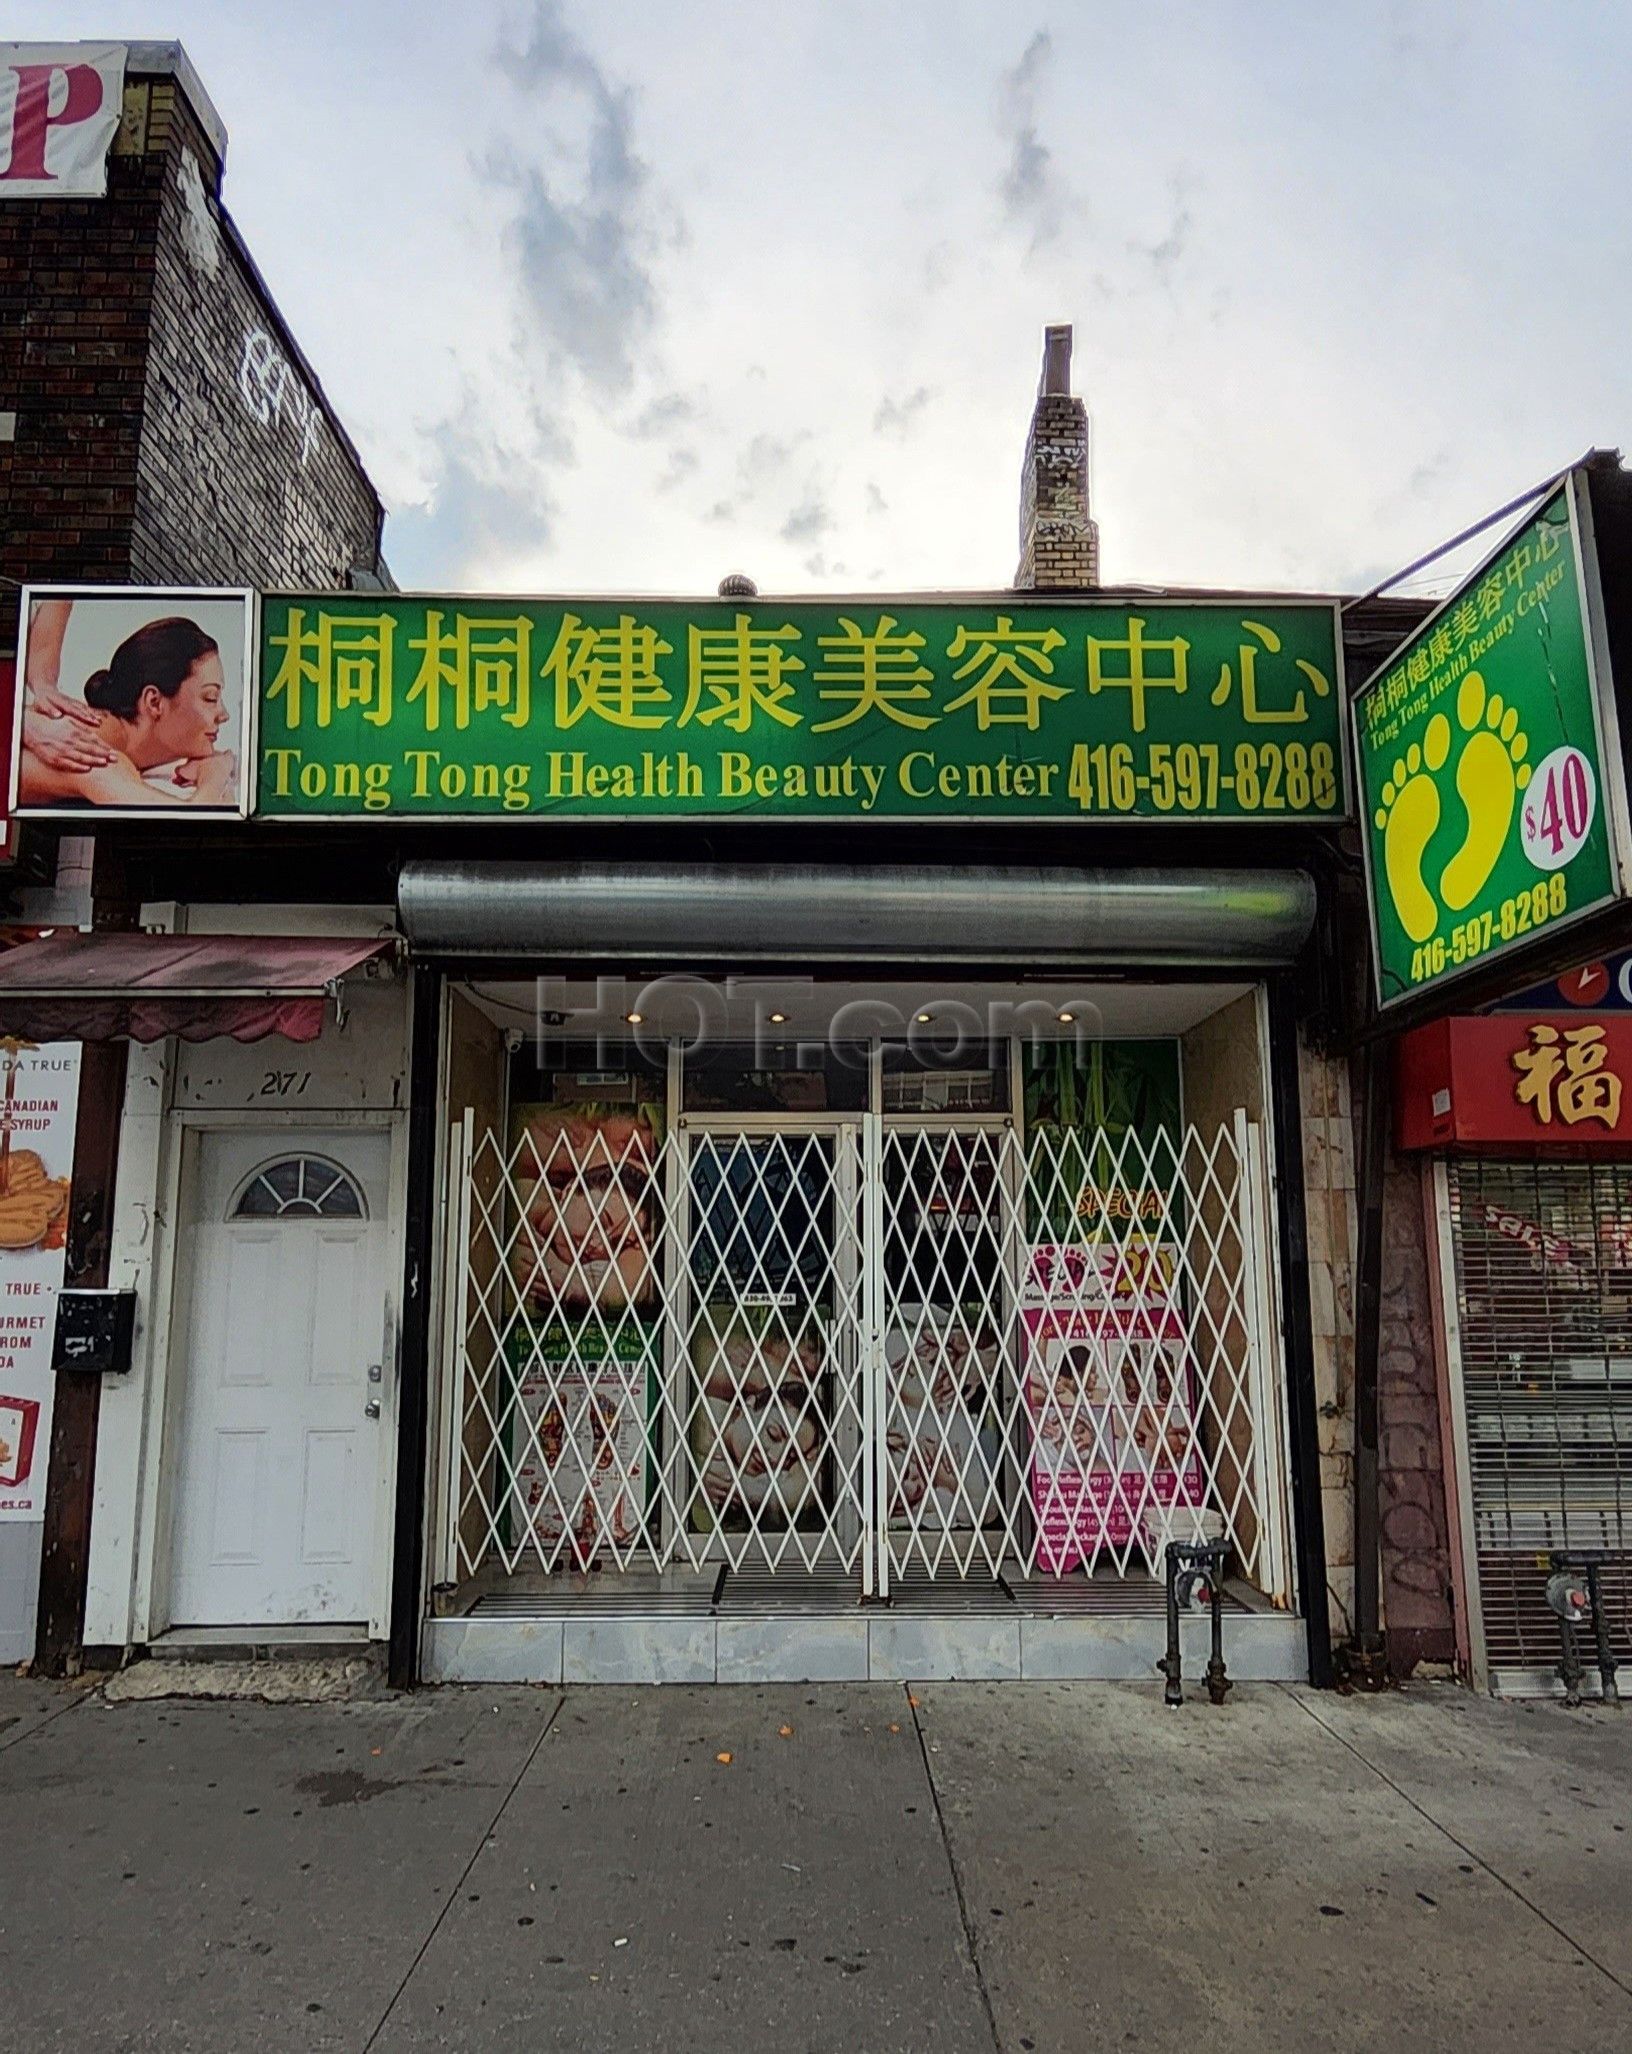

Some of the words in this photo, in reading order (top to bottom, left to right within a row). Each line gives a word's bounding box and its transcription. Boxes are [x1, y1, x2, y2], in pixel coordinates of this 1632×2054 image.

[264, 607, 1331, 733] 桐桐健康美容中心
[1370, 716, 1400, 750] Tong
[1398, 693, 1429, 728] Tong
[1428, 651, 1469, 700] Health
[1468, 610, 1515, 664] Beauty
[1516, 560, 1566, 617] Center
[264, 749, 393, 811] Tong
[403, 750, 533, 811] Tong
[545, 751, 705, 798] Health
[717, 752, 886, 810] Beauty
[898, 751, 1060, 798] Center
[1067, 742, 1337, 812] 416-597-8288
[1411, 872, 1568, 983] 416-597-8288
[11, 1119, 51, 1130] SYRUP
[1513, 1024, 1623, 1129] 福
[6, 1283, 41, 1295] TRUE
